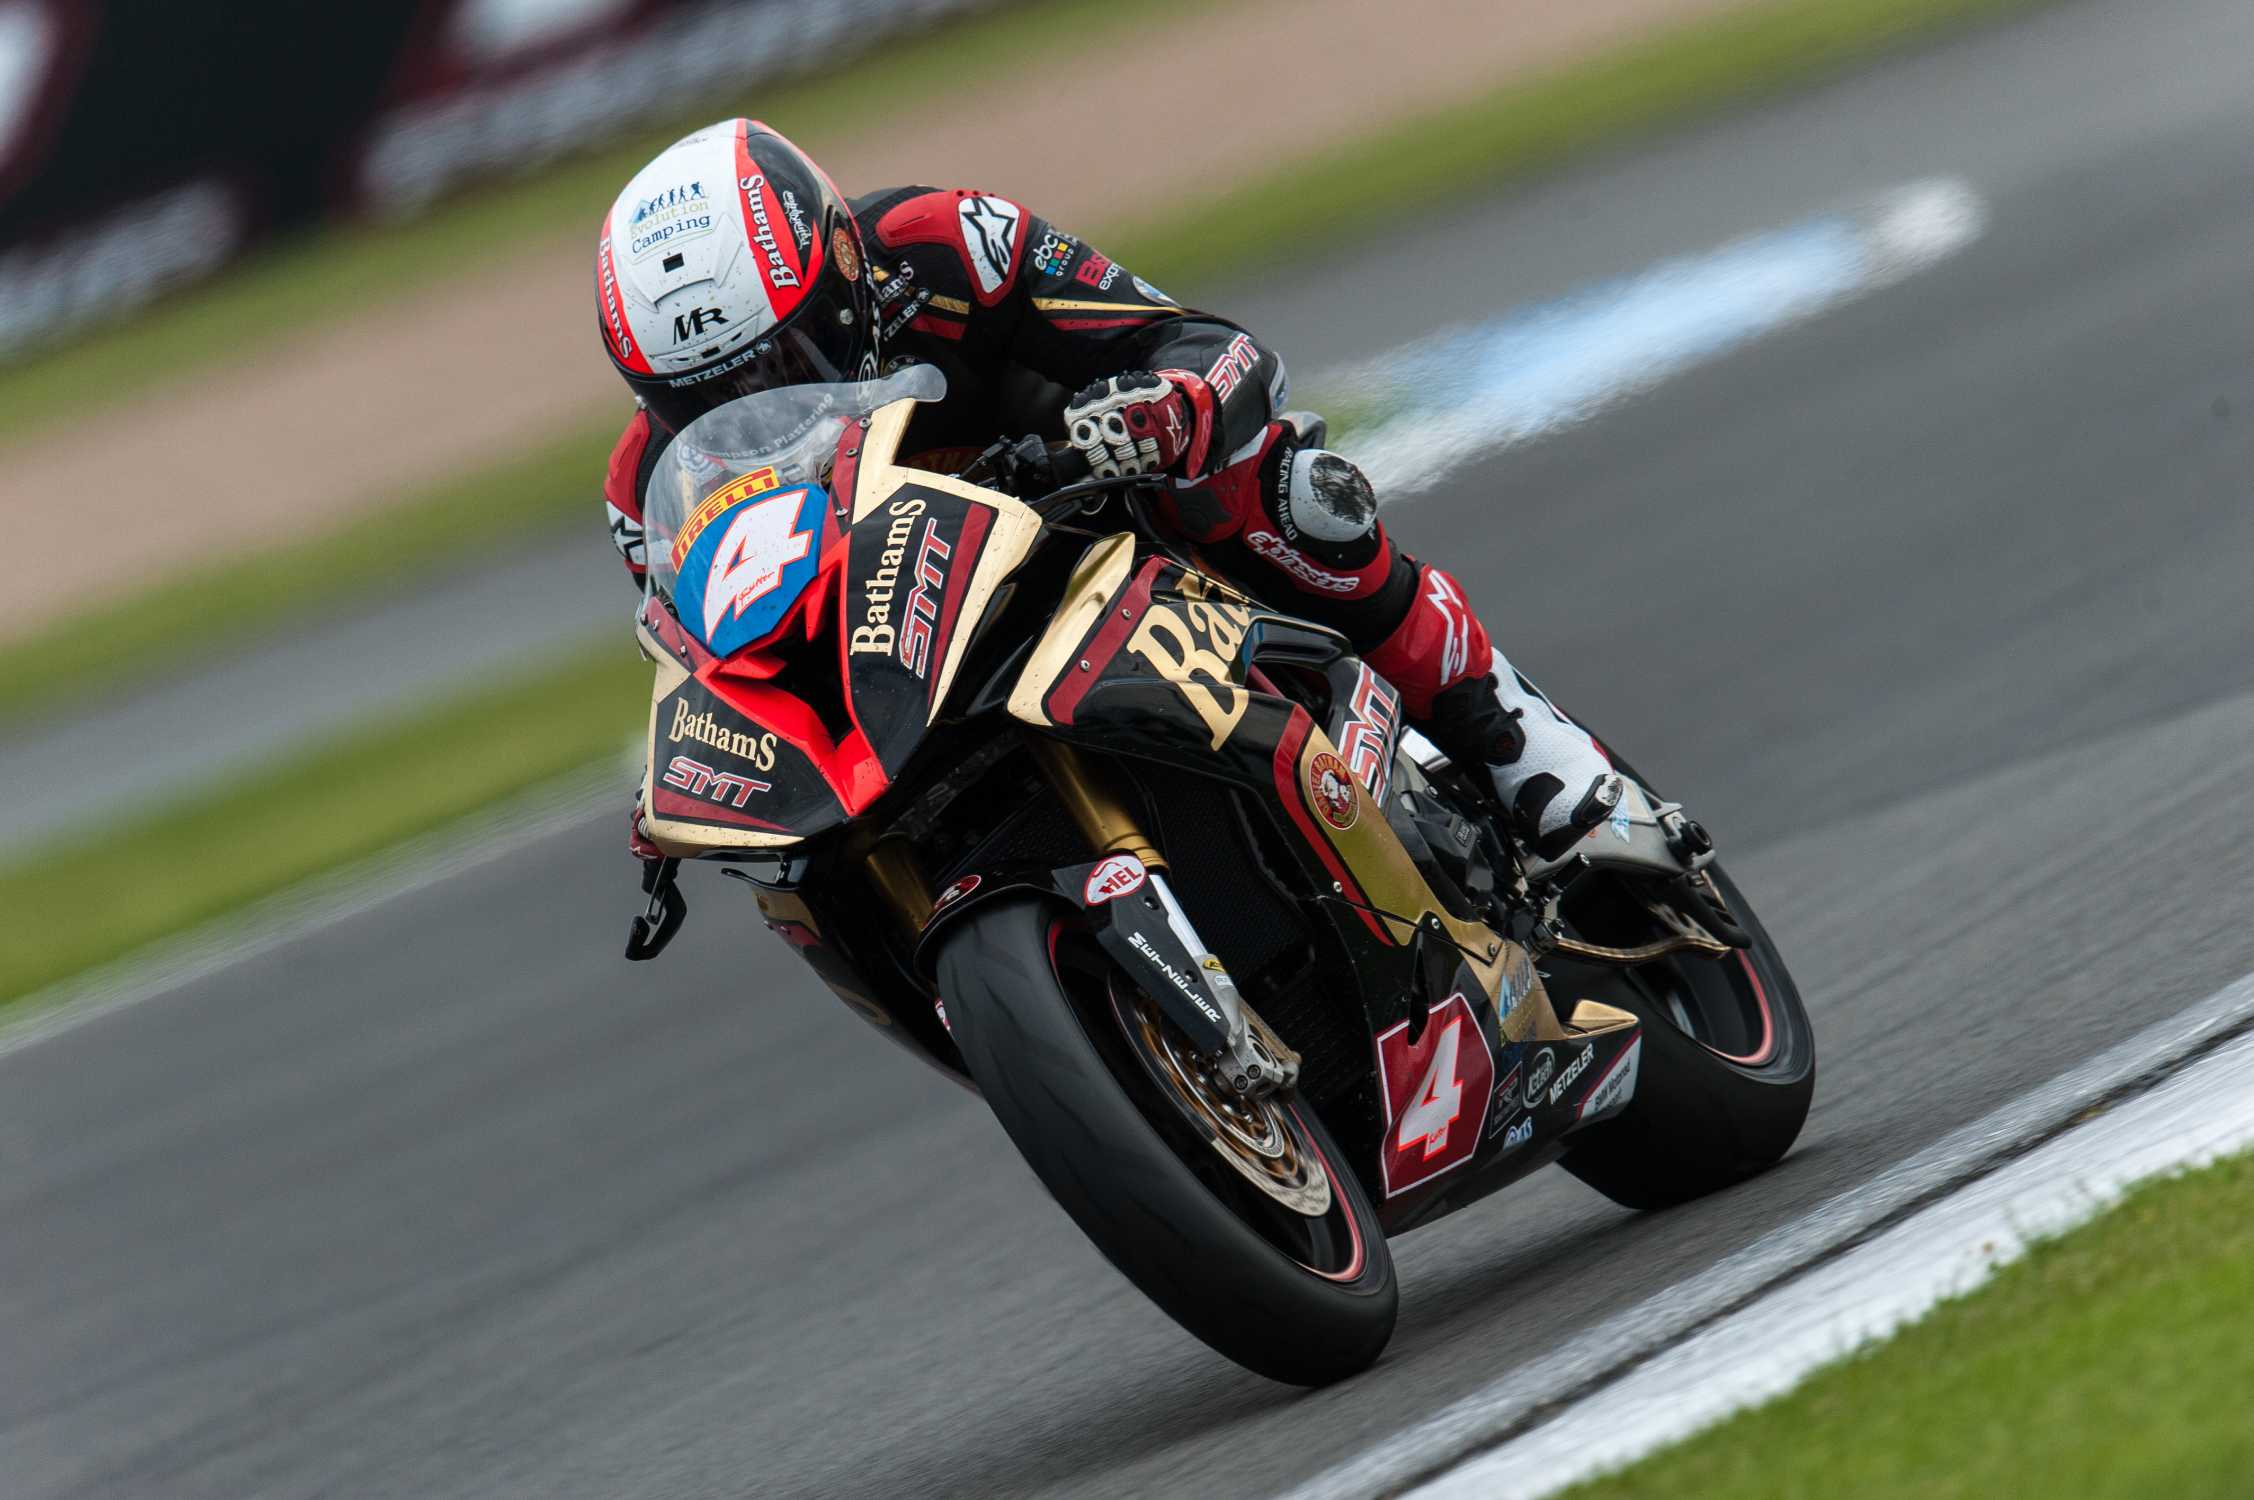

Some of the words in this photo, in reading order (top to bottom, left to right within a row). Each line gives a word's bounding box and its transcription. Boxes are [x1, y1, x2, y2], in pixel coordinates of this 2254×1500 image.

[631, 215, 712, 254] Camping
[669, 350, 757, 388] METZELER
[1205, 333, 1260, 403] SMT
[1278, 498, 1299, 541] AHEAD
[704, 489, 813, 644] 4
[900, 516, 951, 680] SMT
[1338, 660, 1400, 809] SMT
[663, 755, 772, 807] SMT
[1098, 865, 1142, 895] HEL
[1127, 931, 1221, 1023] METZELER
[1397, 1015, 1464, 1163] 4
[1549, 1042, 1594, 1105] METZELER
